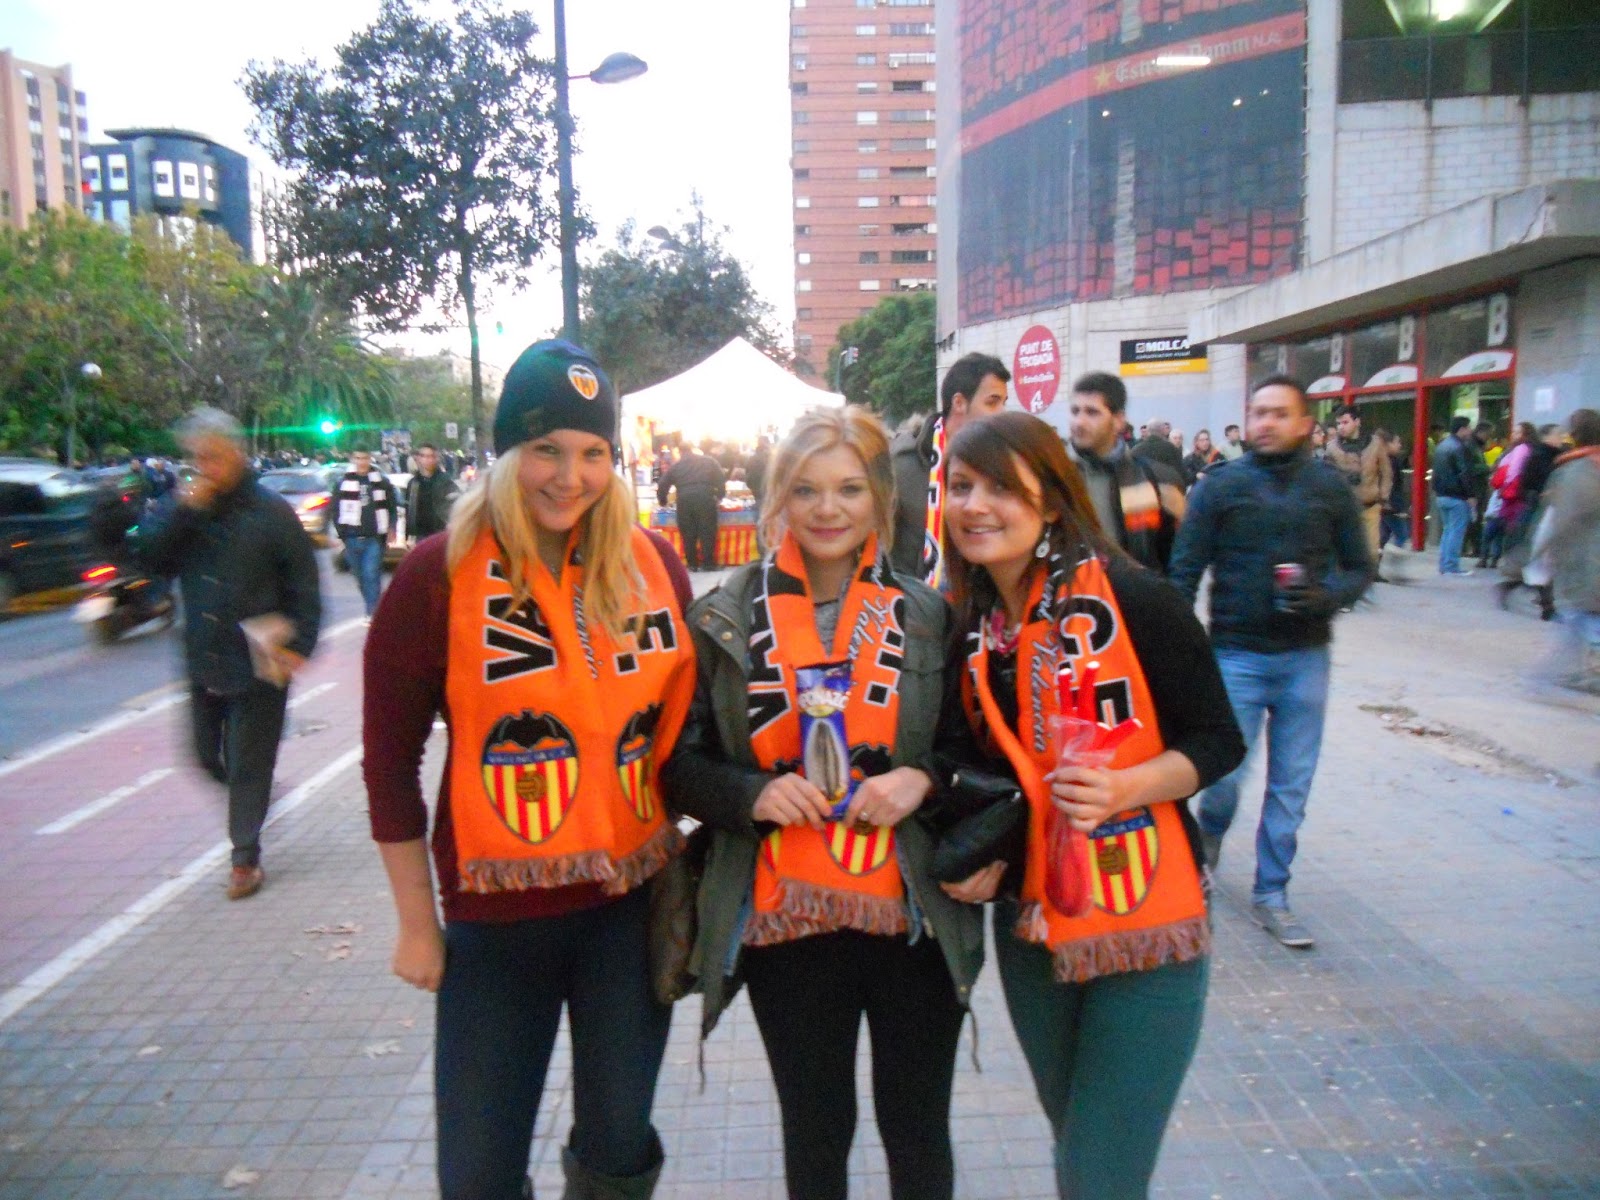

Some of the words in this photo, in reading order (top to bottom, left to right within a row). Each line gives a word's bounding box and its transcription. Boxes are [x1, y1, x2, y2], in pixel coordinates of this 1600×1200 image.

[1020, 341, 1040, 356] PUNT
[1041, 339, 1053, 352] DE
[1146, 339, 1190, 352] MOLCA
